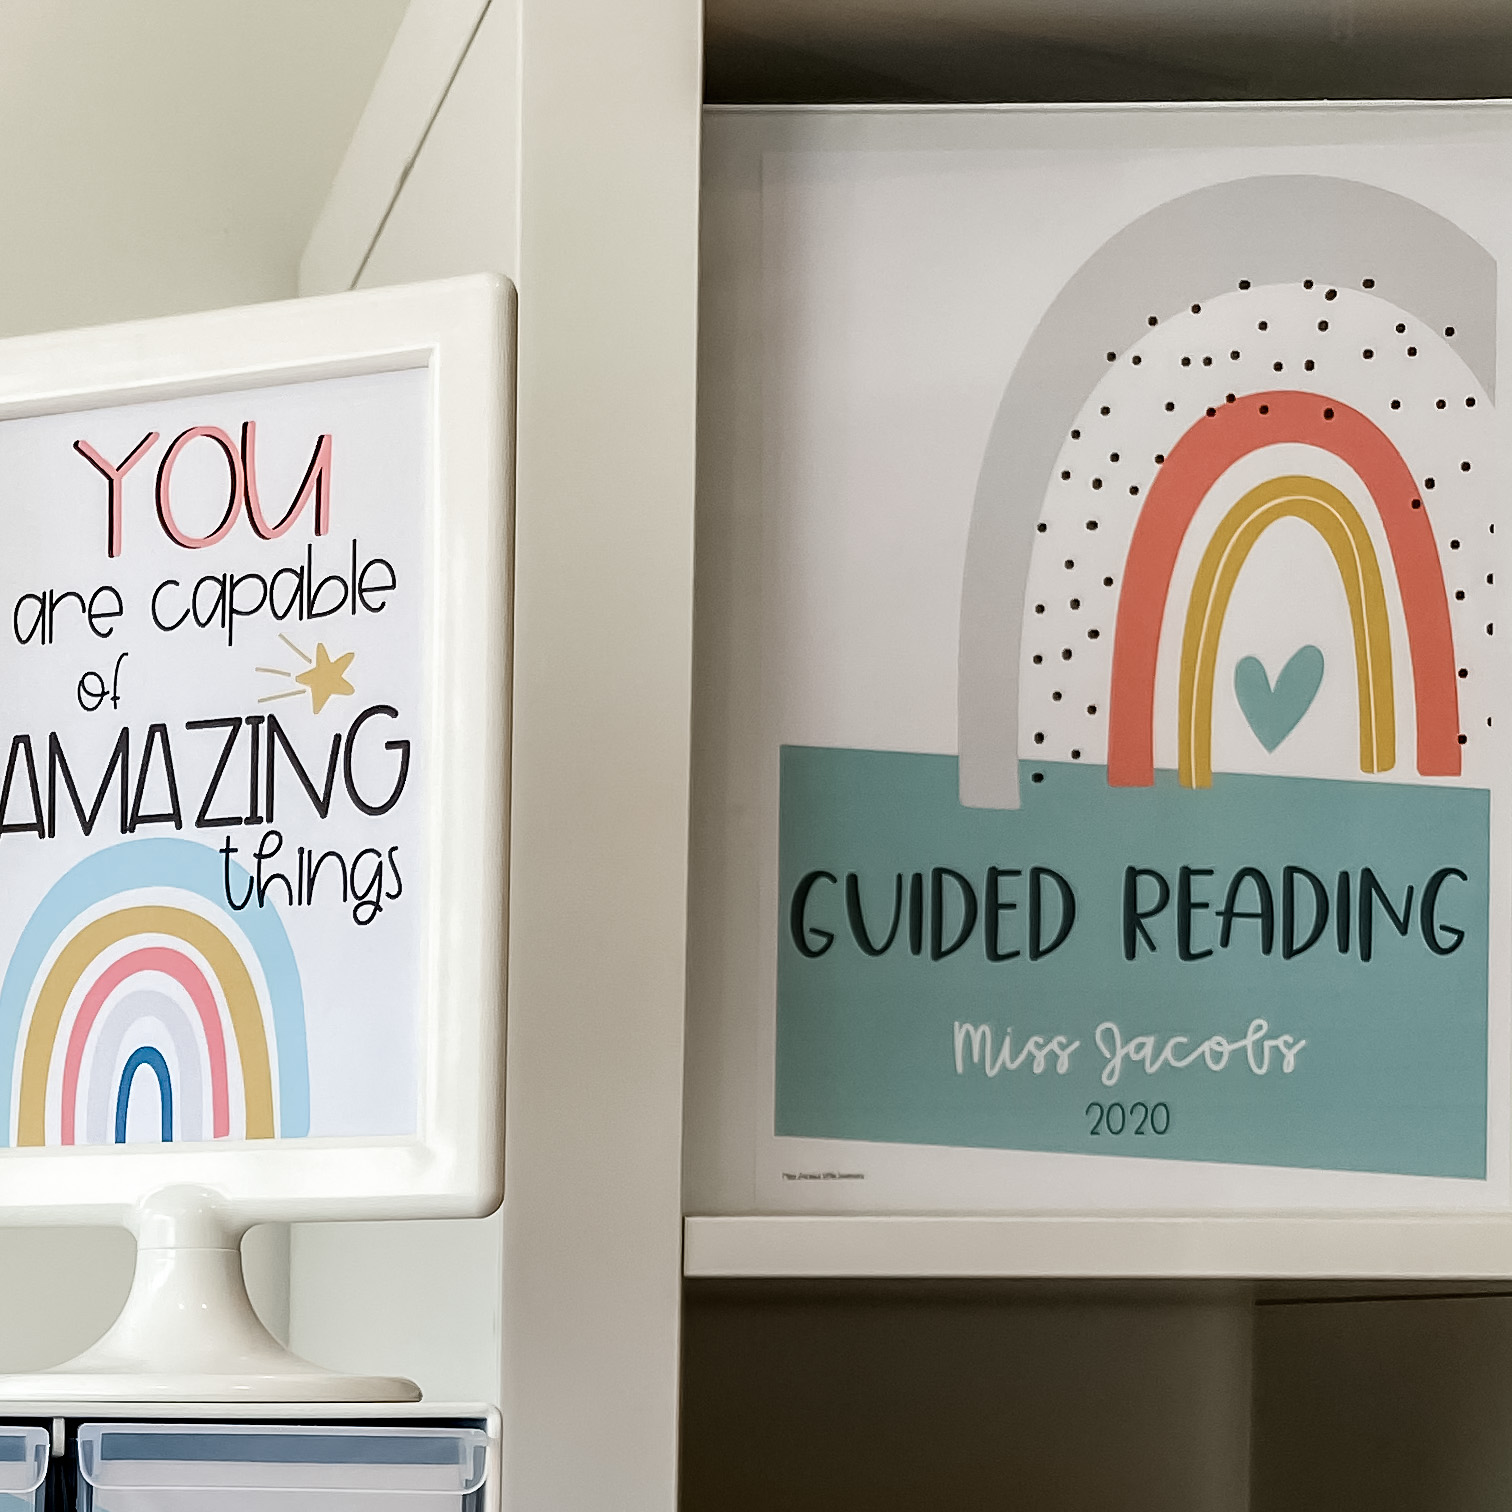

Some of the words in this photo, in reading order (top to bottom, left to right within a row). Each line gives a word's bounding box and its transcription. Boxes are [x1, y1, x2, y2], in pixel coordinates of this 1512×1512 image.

[72, 420, 333, 558] YOU
[12, 584, 124, 646] are
[151, 538, 397, 646] capable
[76, 652, 129, 712] of
[220, 830, 404, 926] things
[789, 865, 1077, 963] GUIDED
[1122, 865, 1469, 963] READING
[952, 1020, 1080, 1077] Miss
[1094, 1018, 1307, 1087] Jacobs
[1085, 1102, 1171, 1136] 2020
